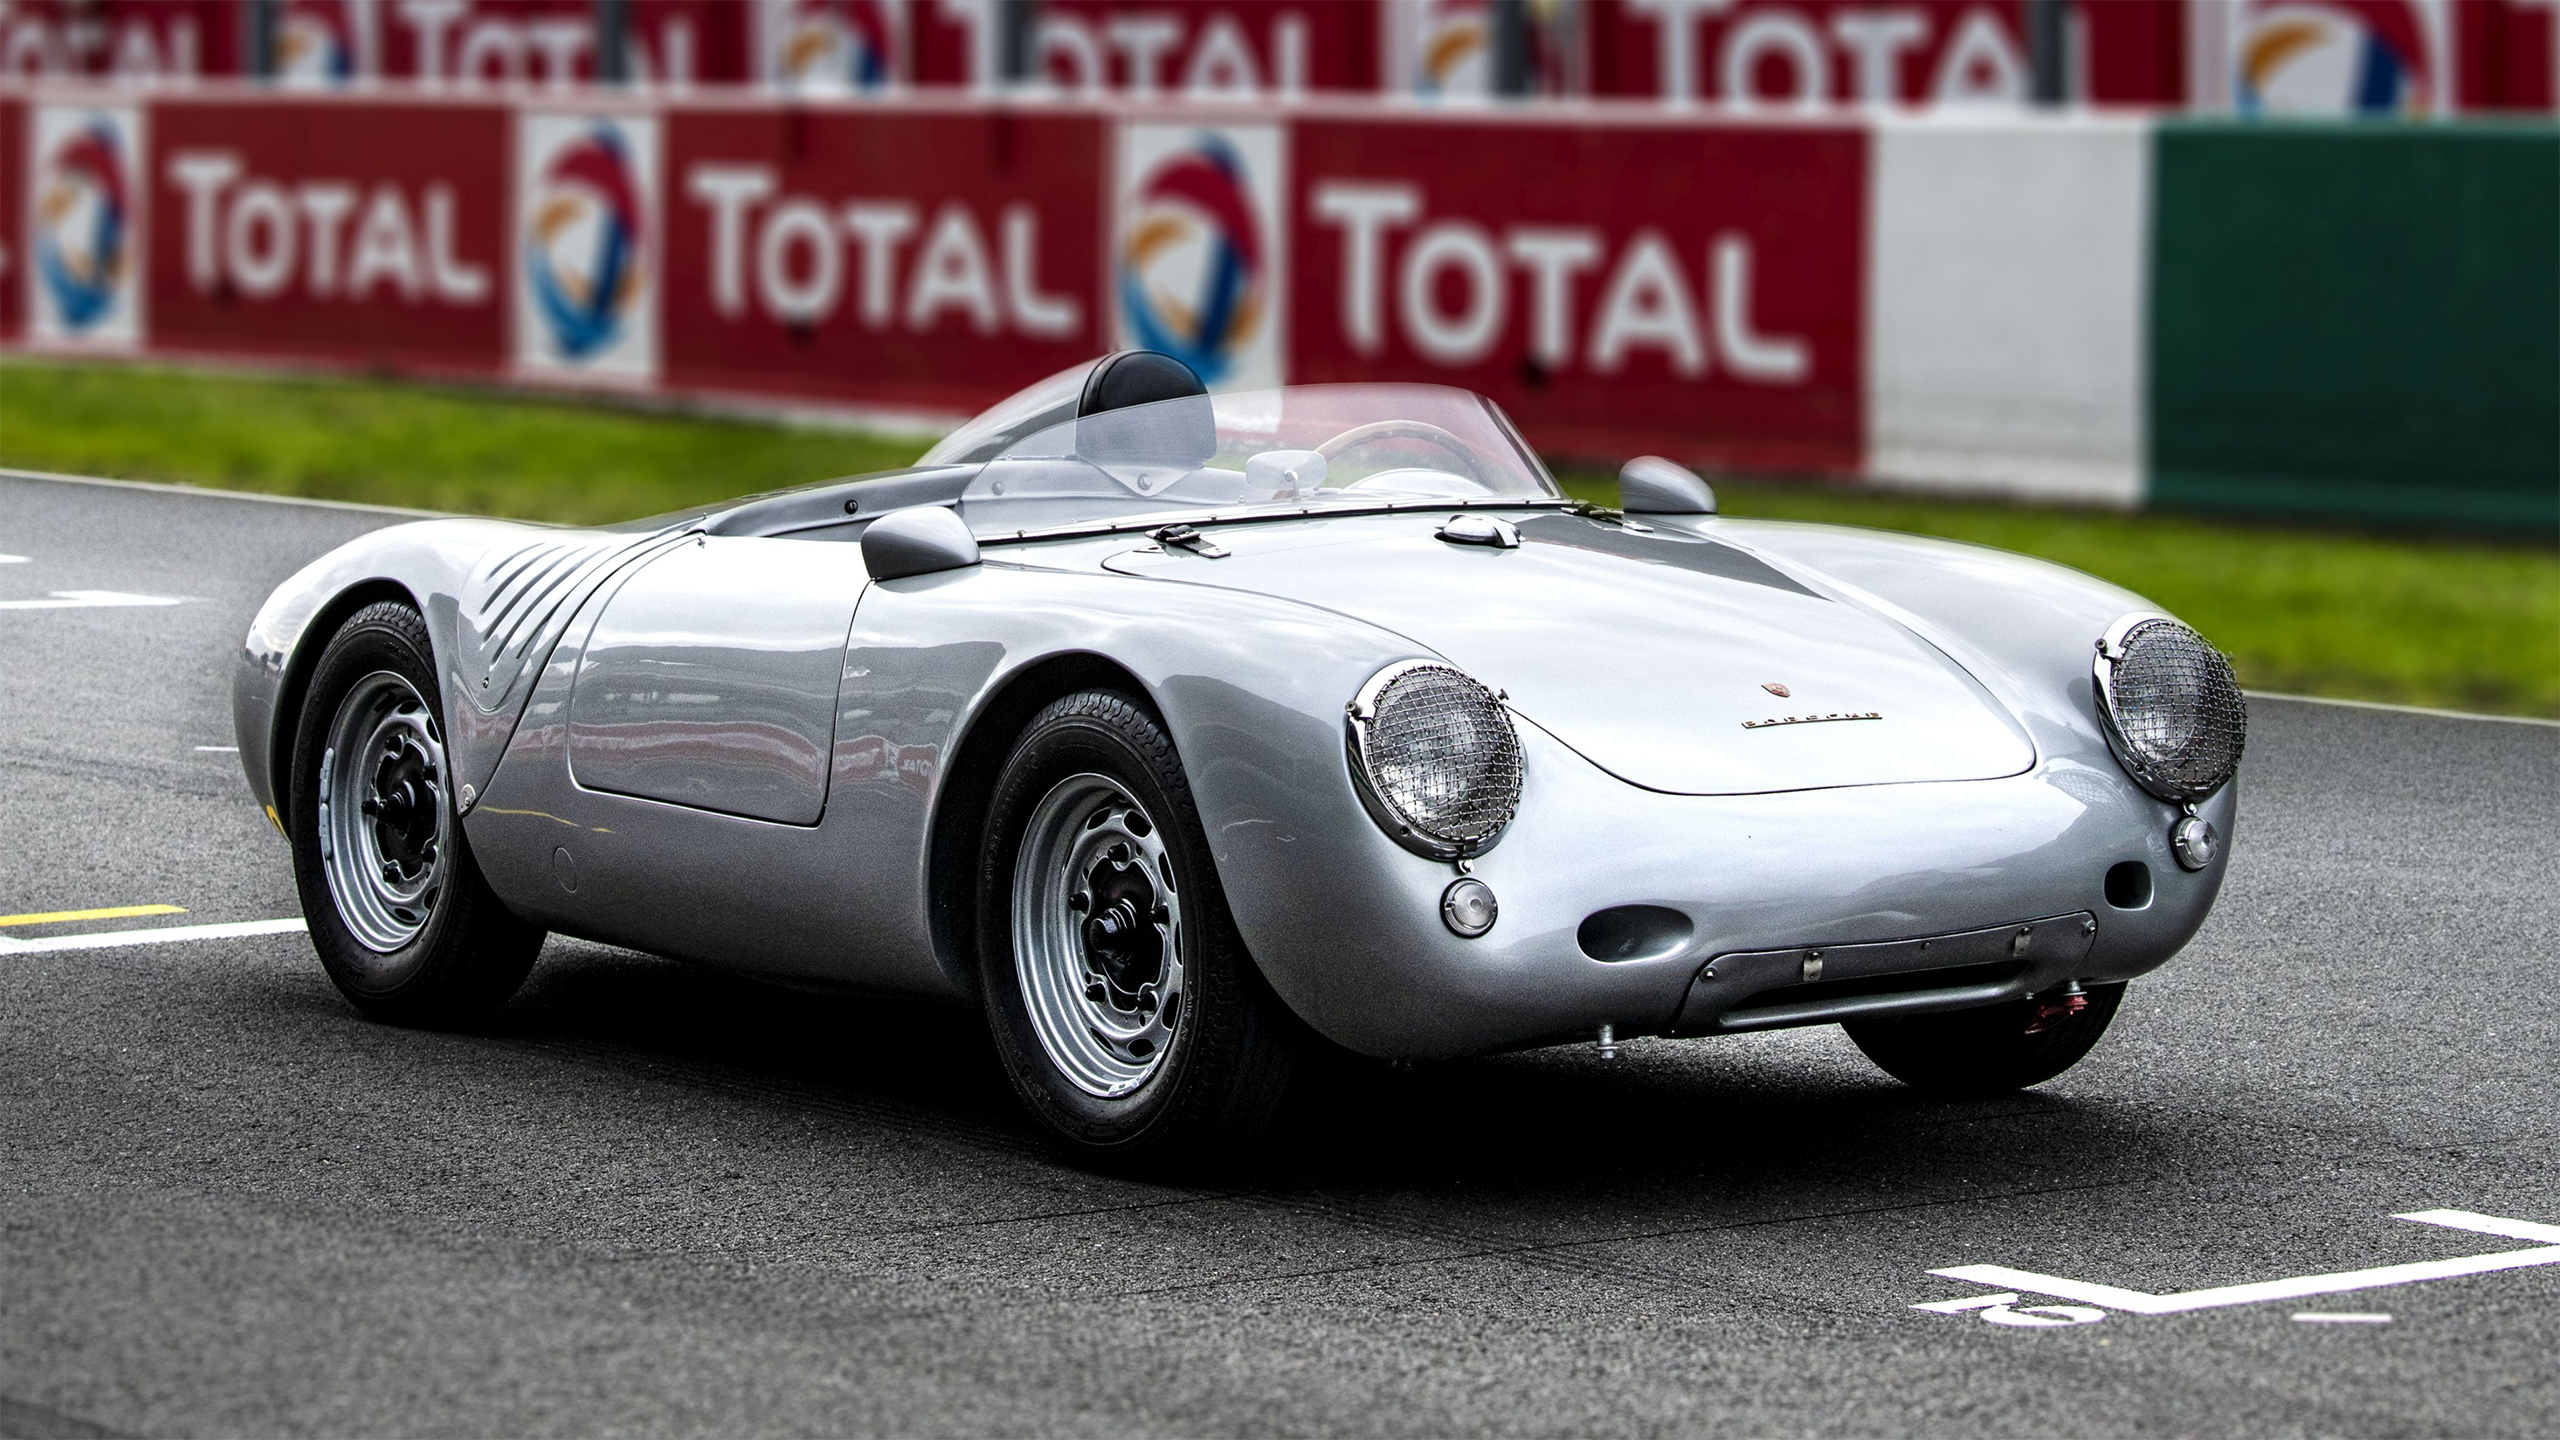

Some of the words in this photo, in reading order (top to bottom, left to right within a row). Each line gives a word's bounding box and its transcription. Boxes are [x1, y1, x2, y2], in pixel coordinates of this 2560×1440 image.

[171, 154, 487, 297] TOTAL
[690, 166, 1077, 331] TOTAL
[1313, 183, 1805, 378] TOTAL
